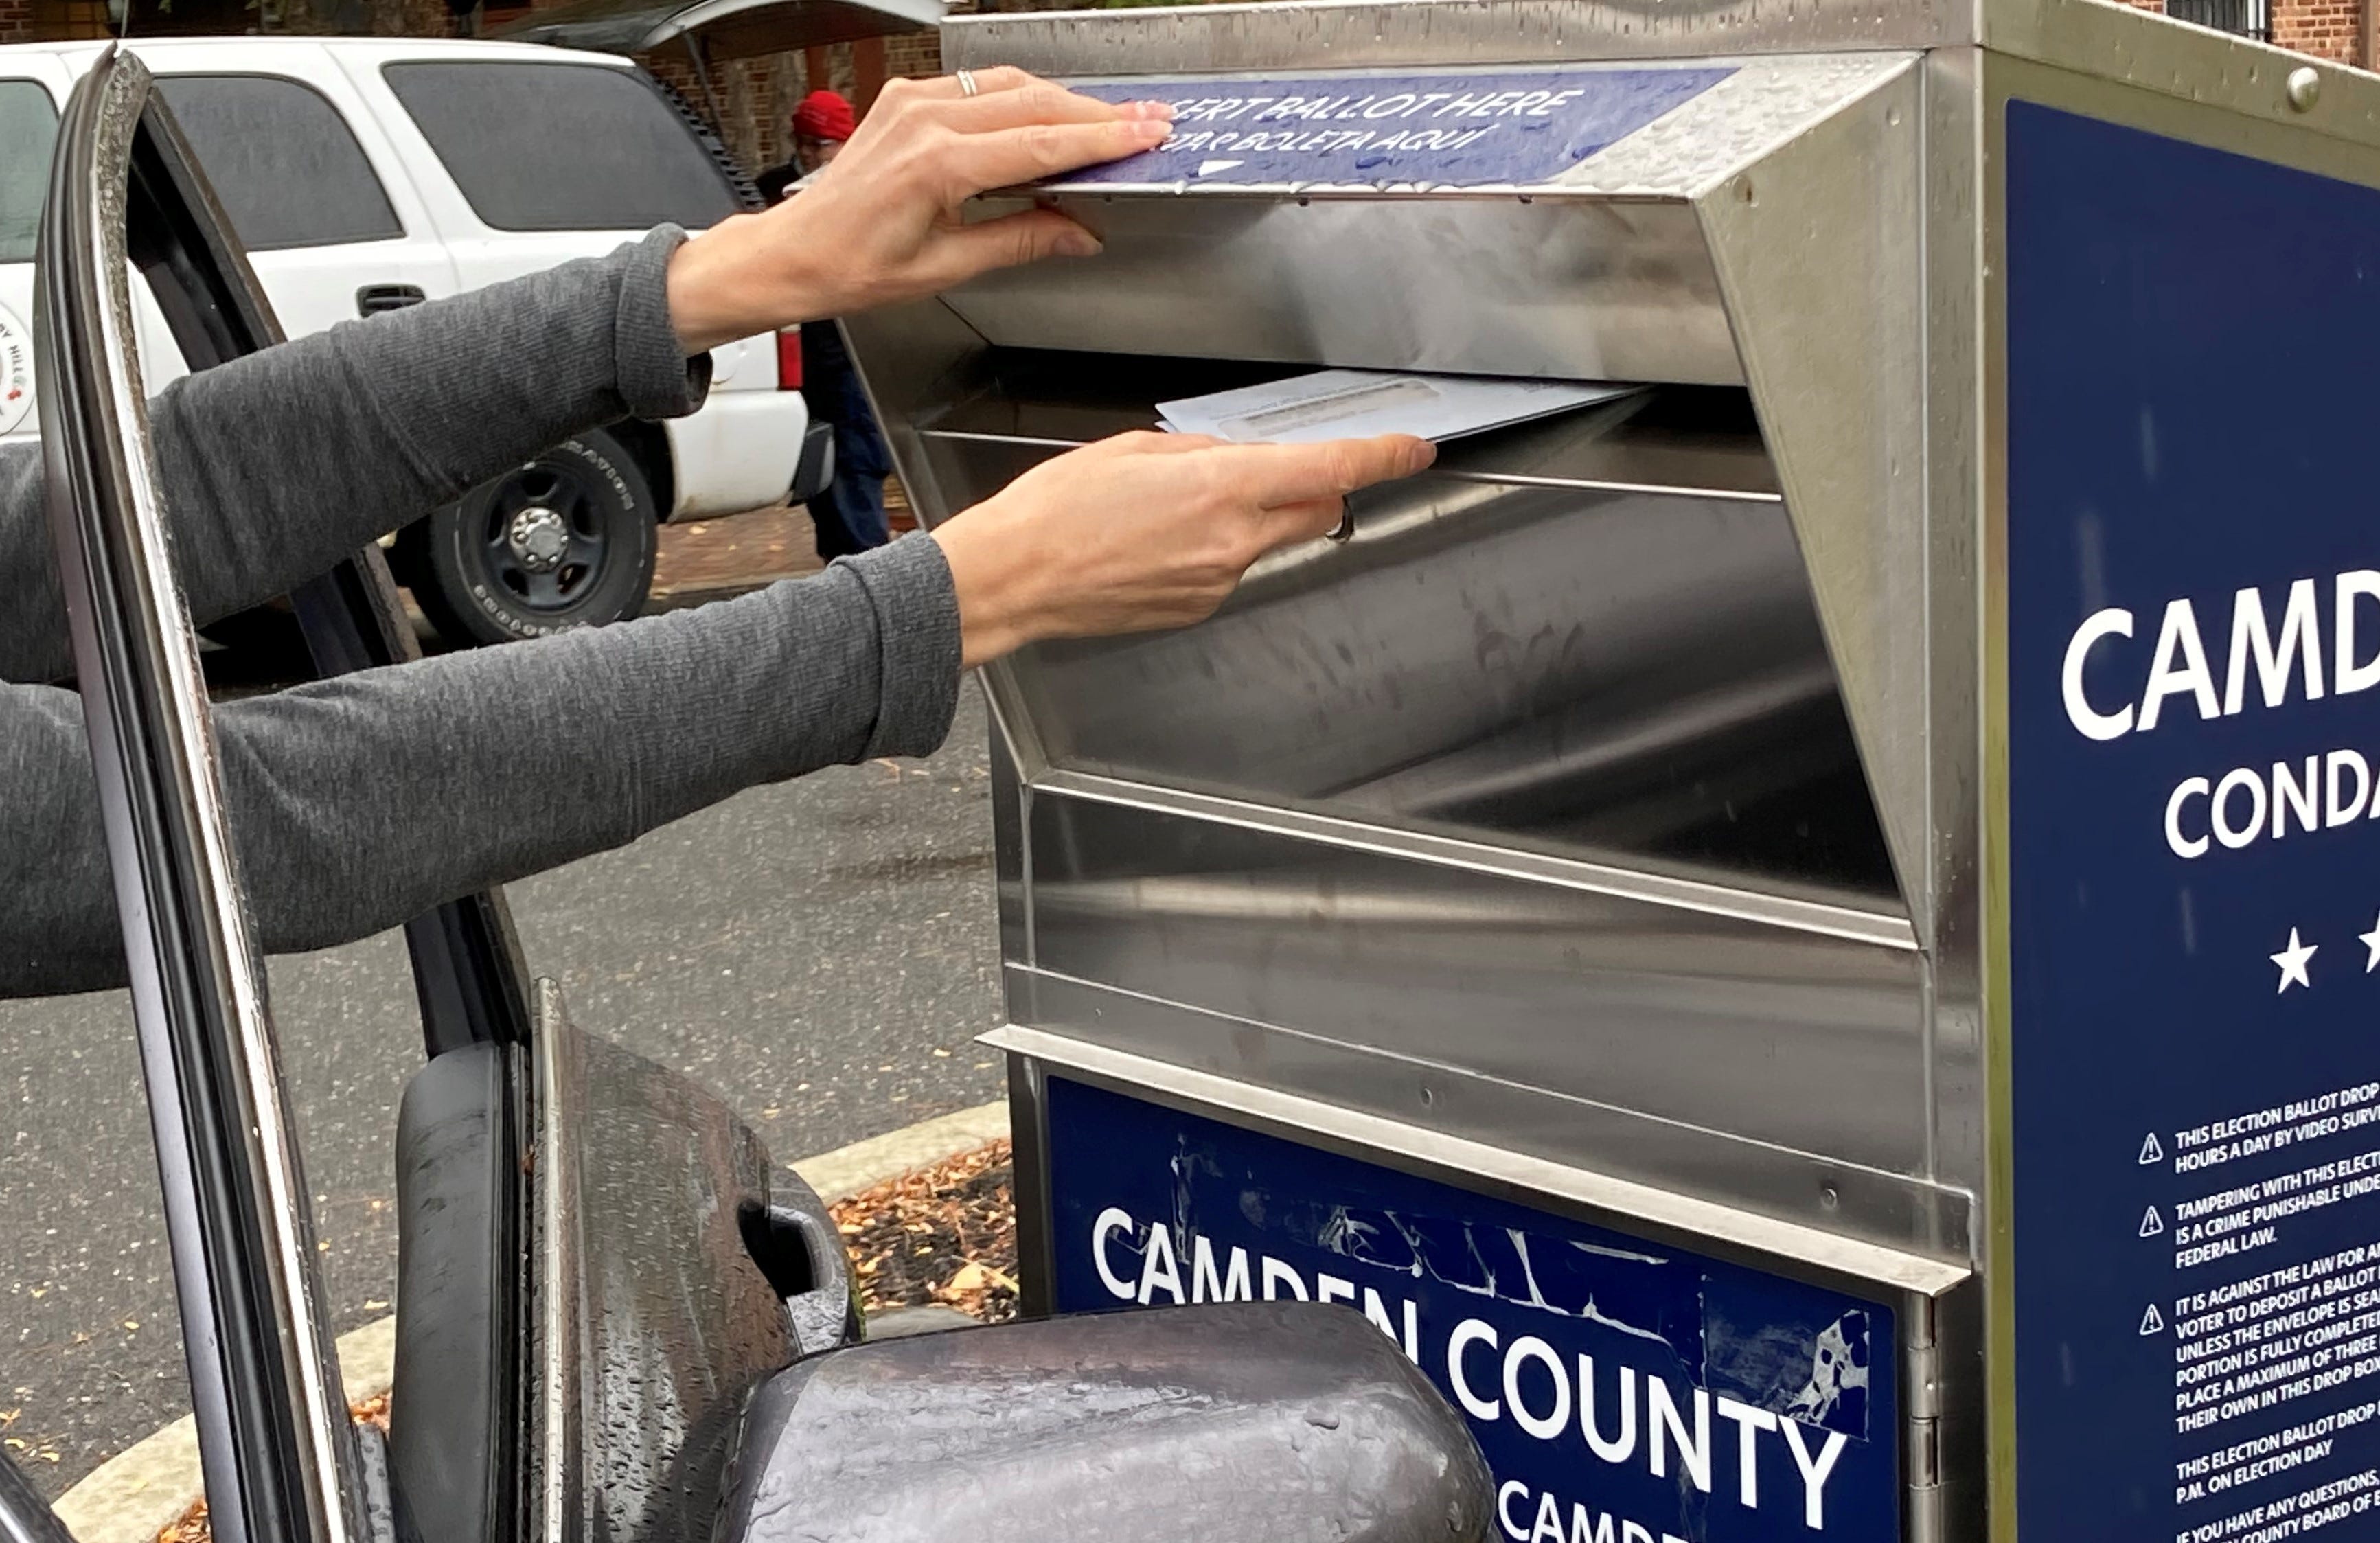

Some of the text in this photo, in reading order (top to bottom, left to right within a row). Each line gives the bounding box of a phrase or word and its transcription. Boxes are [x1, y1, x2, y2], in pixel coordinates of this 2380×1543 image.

[1253, 93, 1452, 121] BALLOT
[1431, 89, 1585, 118] HERE
[1226, 130, 1377, 152] BOLETA
[2175, 1083, 2379, 1148] THIS ELECTION BALLOT DROP
[2176, 1145, 2228, 1173] HOURS
[2229, 1143, 2241, 1158] A
[2243, 1133, 2272, 1156] DAY
[2275, 1128, 2294, 1147] BY
[2294, 1117, 2339, 1141] VIDEO
[2175, 1184, 2260, 1220] TAMPERING
[2262, 1173, 2301, 1197] WITH
[2303, 1163, 2335, 1185] THIS
[2176, 1226, 2189, 1245] IS
[2192, 1224, 2204, 1241] A
[2205, 1210, 2251, 1236] CRIME
[2253, 1185, 2341, 1224] PUNISHABLE
[2176, 1226, 2277, 1268] FEDERAL LAW.
[2175, 1266, 2377, 1339] VOTER TO DEPOSIT A BALLOT
[2176, 1297, 2190, 1316] IT
[2193, 1294, 2206, 1311] IS
[2208, 1275, 2271, 1307] AGAINST
[2272, 1266, 2300, 1287] THE
[2302, 1256, 2335, 1279] LAW
[2337, 1248, 2365, 1269] FOR
[2177, 1333, 2231, 1362] UNLESS
[2233, 1324, 2261, 1346] THE
[2264, 1302, 2335, 1337] ENVELOPE
[2338, 1297, 2351, 1314] IS
[2177, 1353, 2241, 1386] PORTION
[2245, 1348, 2258, 1366] IS
[2261, 1334, 2302, 1361] FULLY
[2177, 1334, 2377, 1410] PLACE A MAXIMUM OF THREE
[1447, 1318, 1849, 1531] COUNTY
[2176, 1407, 2218, 1432] THEIR
[2221, 1394, 2258, 1419] OWN
[2262, 1388, 2277, 1407] IN
[2279, 1378, 2311, 1400] THIS
[2313, 1365, 2352, 1391] DROP
[2177, 1403, 2375, 1480] THIS ELECTION BALLOT DROP
[2208, 1472, 2231, 1493] ON
[2234, 1449, 2302, 1485] ELECTION
[2304, 1439, 2333, 1462] DAY
[2192, 1521, 2223, 1543] YOU
[2225, 1507, 2264, 1533] HAVE
[2266, 1496, 2297, 1520] ANY
[2241, 1518, 2300, 1543] COUNTY
[2302, 1502, 2350, 1530] BOARD
[2353, 1493, 2372, 1512] OF
